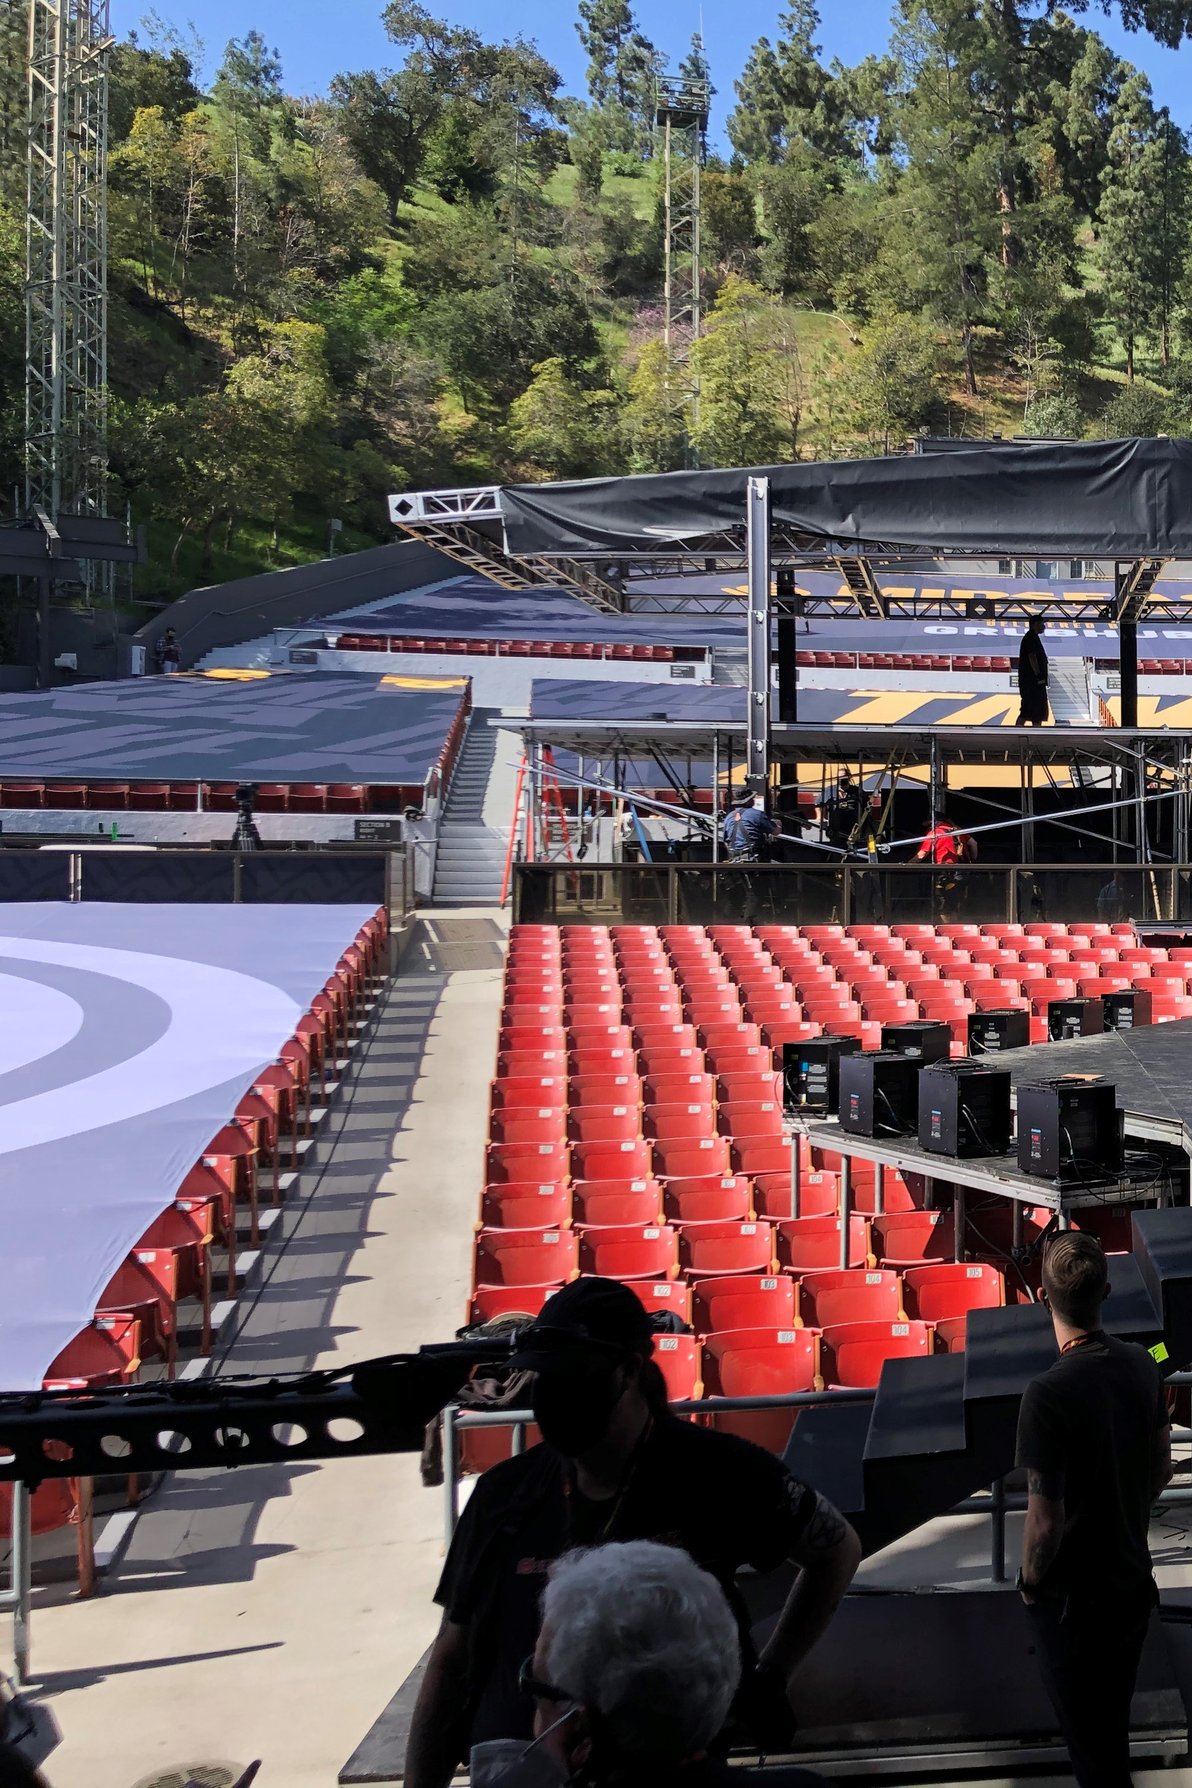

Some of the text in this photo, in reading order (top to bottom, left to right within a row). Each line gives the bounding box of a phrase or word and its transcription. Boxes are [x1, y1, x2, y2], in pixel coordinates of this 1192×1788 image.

[986, 618, 1096, 629] DELIERED
[894, 1325, 908, 1335] 104
[780, 1332, 793, 1341] 103
[663, 1340, 676, 1349] 102
